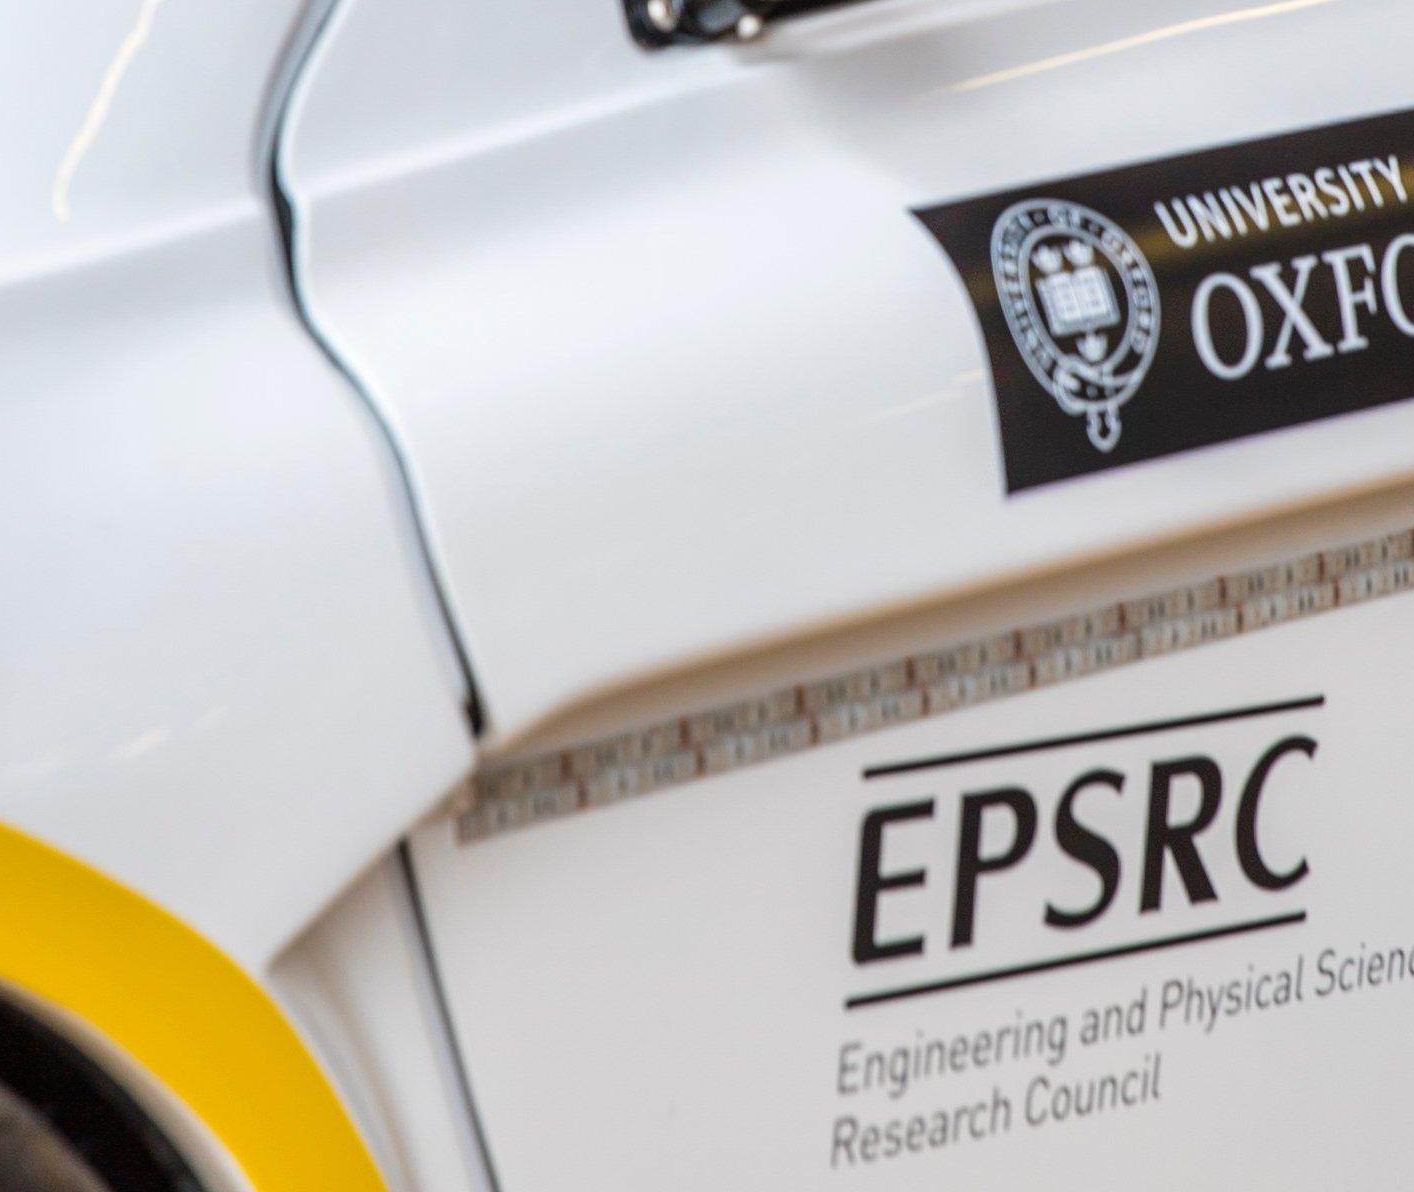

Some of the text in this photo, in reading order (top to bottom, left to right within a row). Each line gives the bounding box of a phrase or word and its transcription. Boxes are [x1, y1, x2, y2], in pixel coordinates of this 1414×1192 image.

[1153, 155, 1411, 249] UNIVERSITY
[850, 733, 1319, 966] EPSRC
[834, 1008, 1068, 1099] Engineering
[1079, 988, 1149, 1048] and
[1158, 955, 1306, 1034] Physical
[828, 1052, 1164, 1170] Research Council
